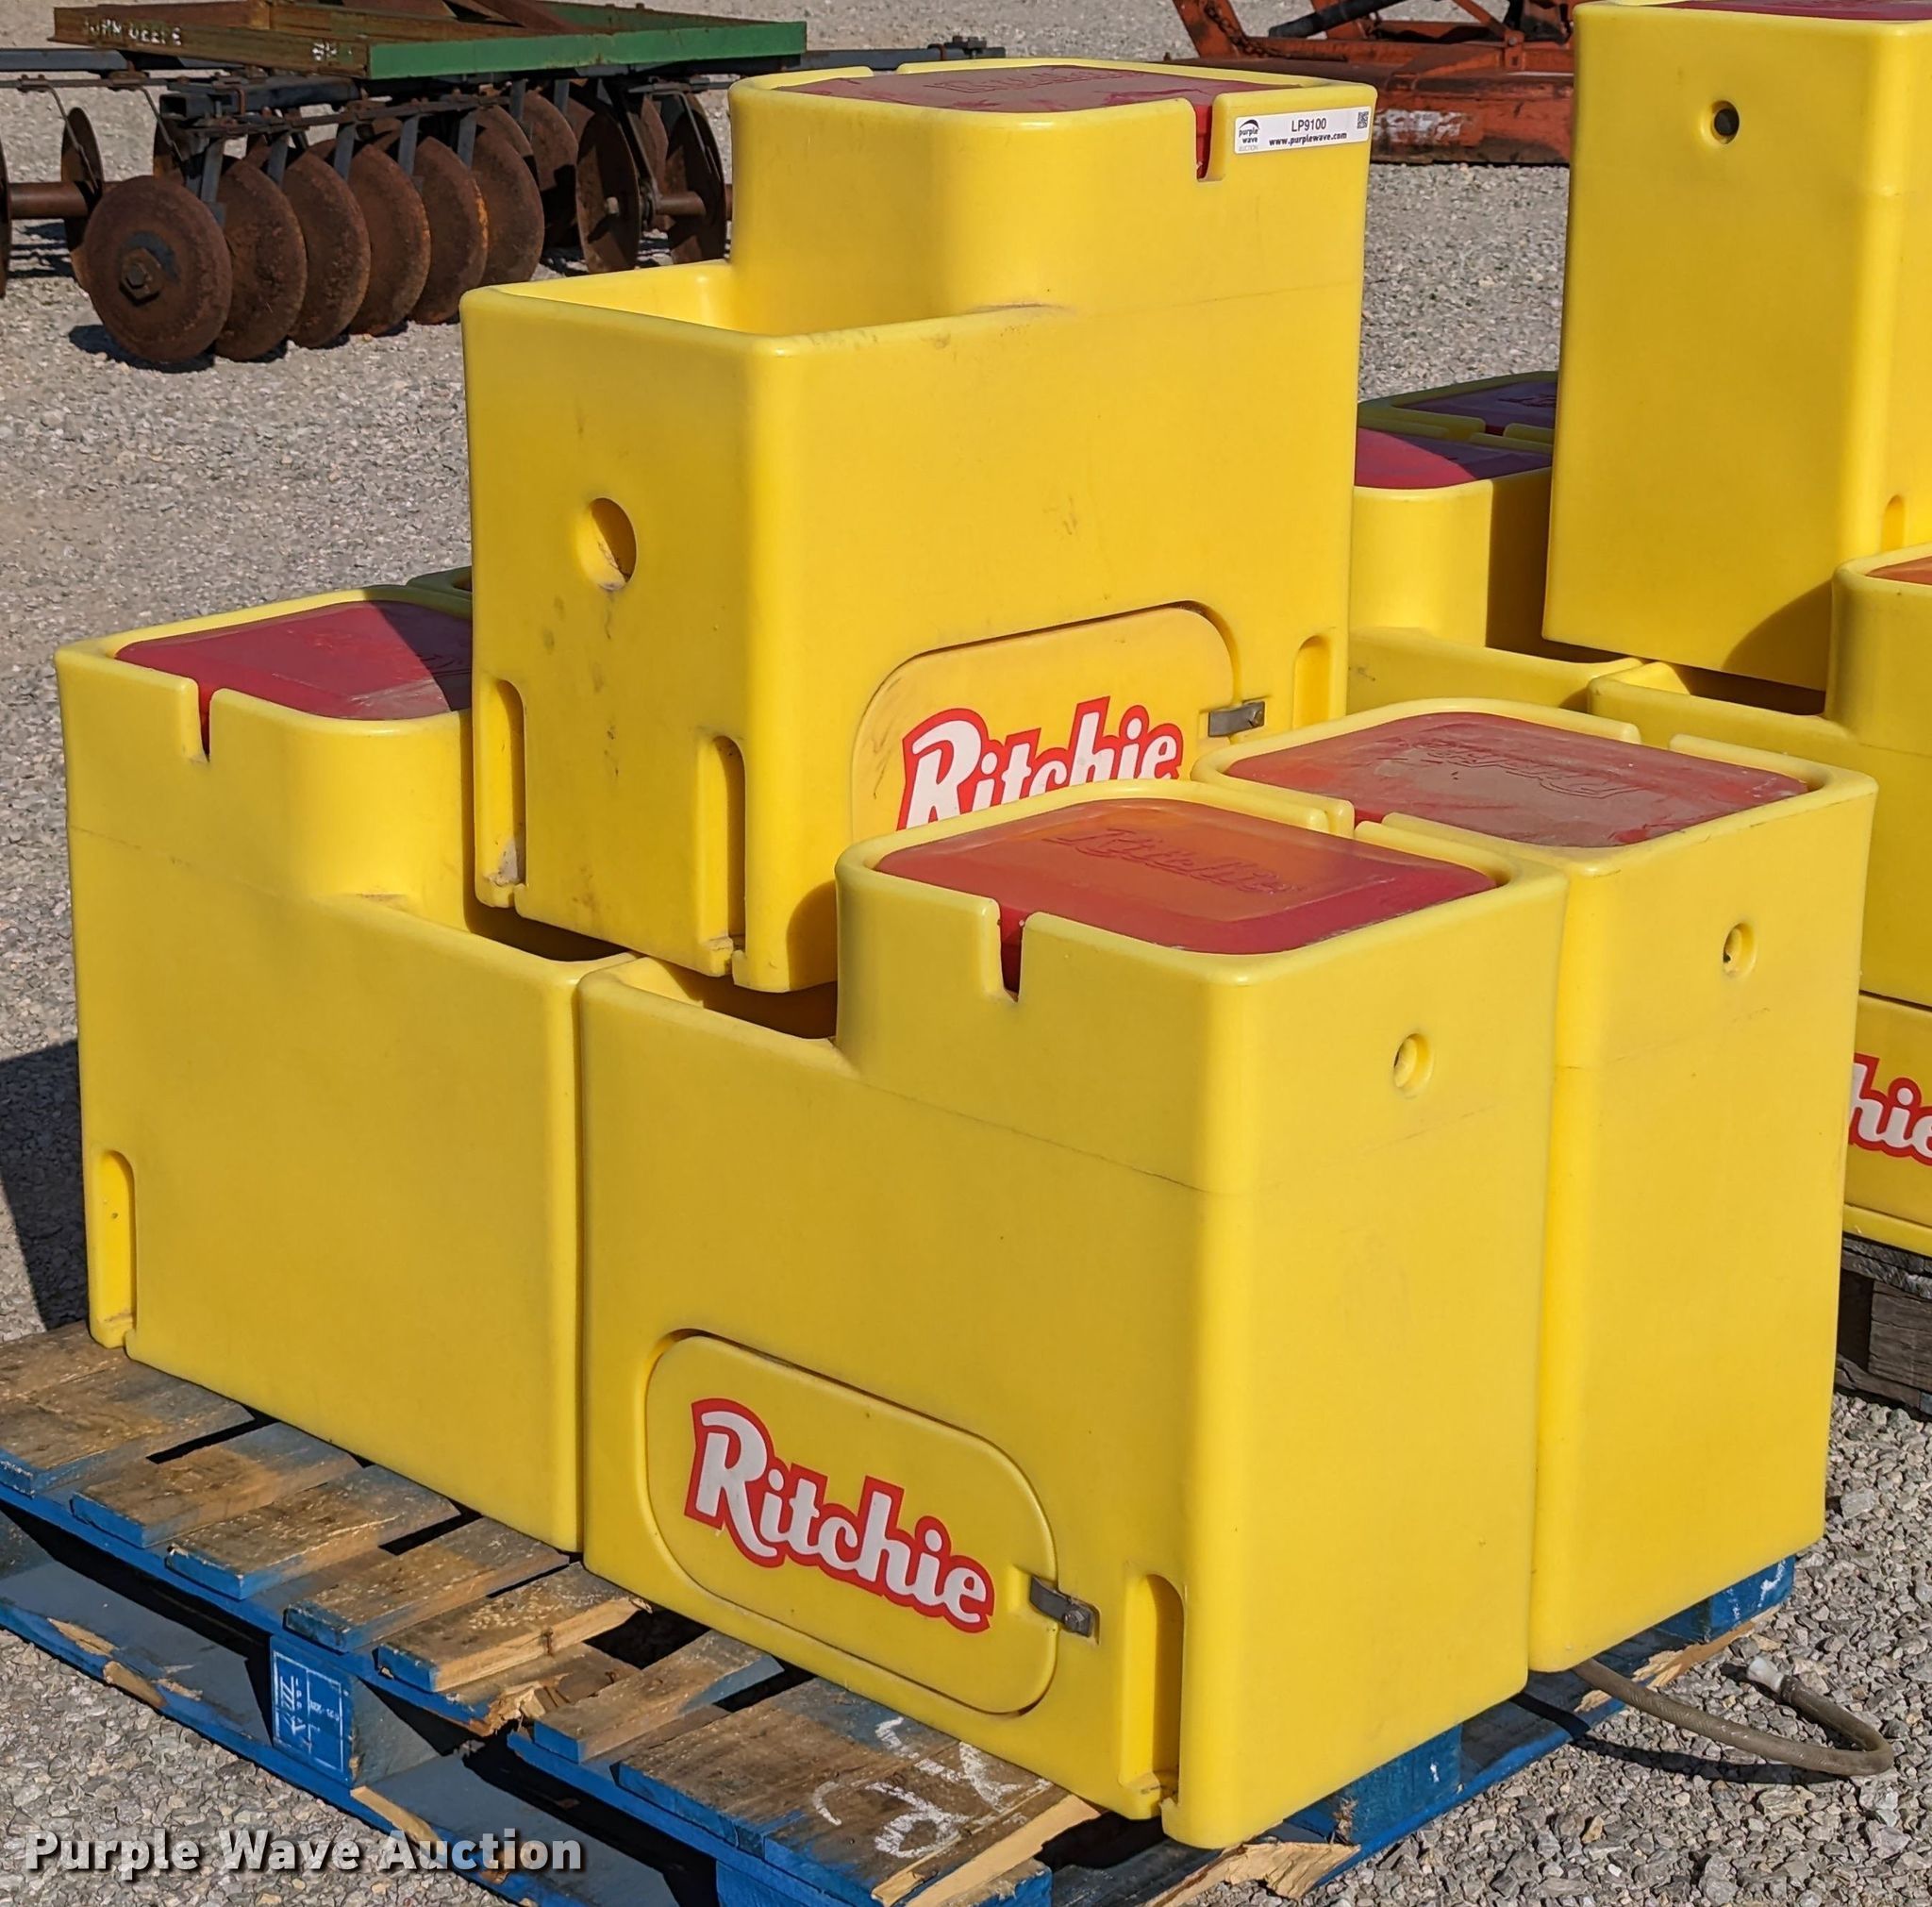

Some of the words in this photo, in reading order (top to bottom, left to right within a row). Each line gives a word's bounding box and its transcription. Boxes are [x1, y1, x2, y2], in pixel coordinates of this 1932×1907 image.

[1239, 126, 1258, 138] purple
[1291, 117, 1327, 132] LP9100
[1269, 131, 1347, 146] www.purplewave.com
[689, 1402, 991, 1630] Ritchie
